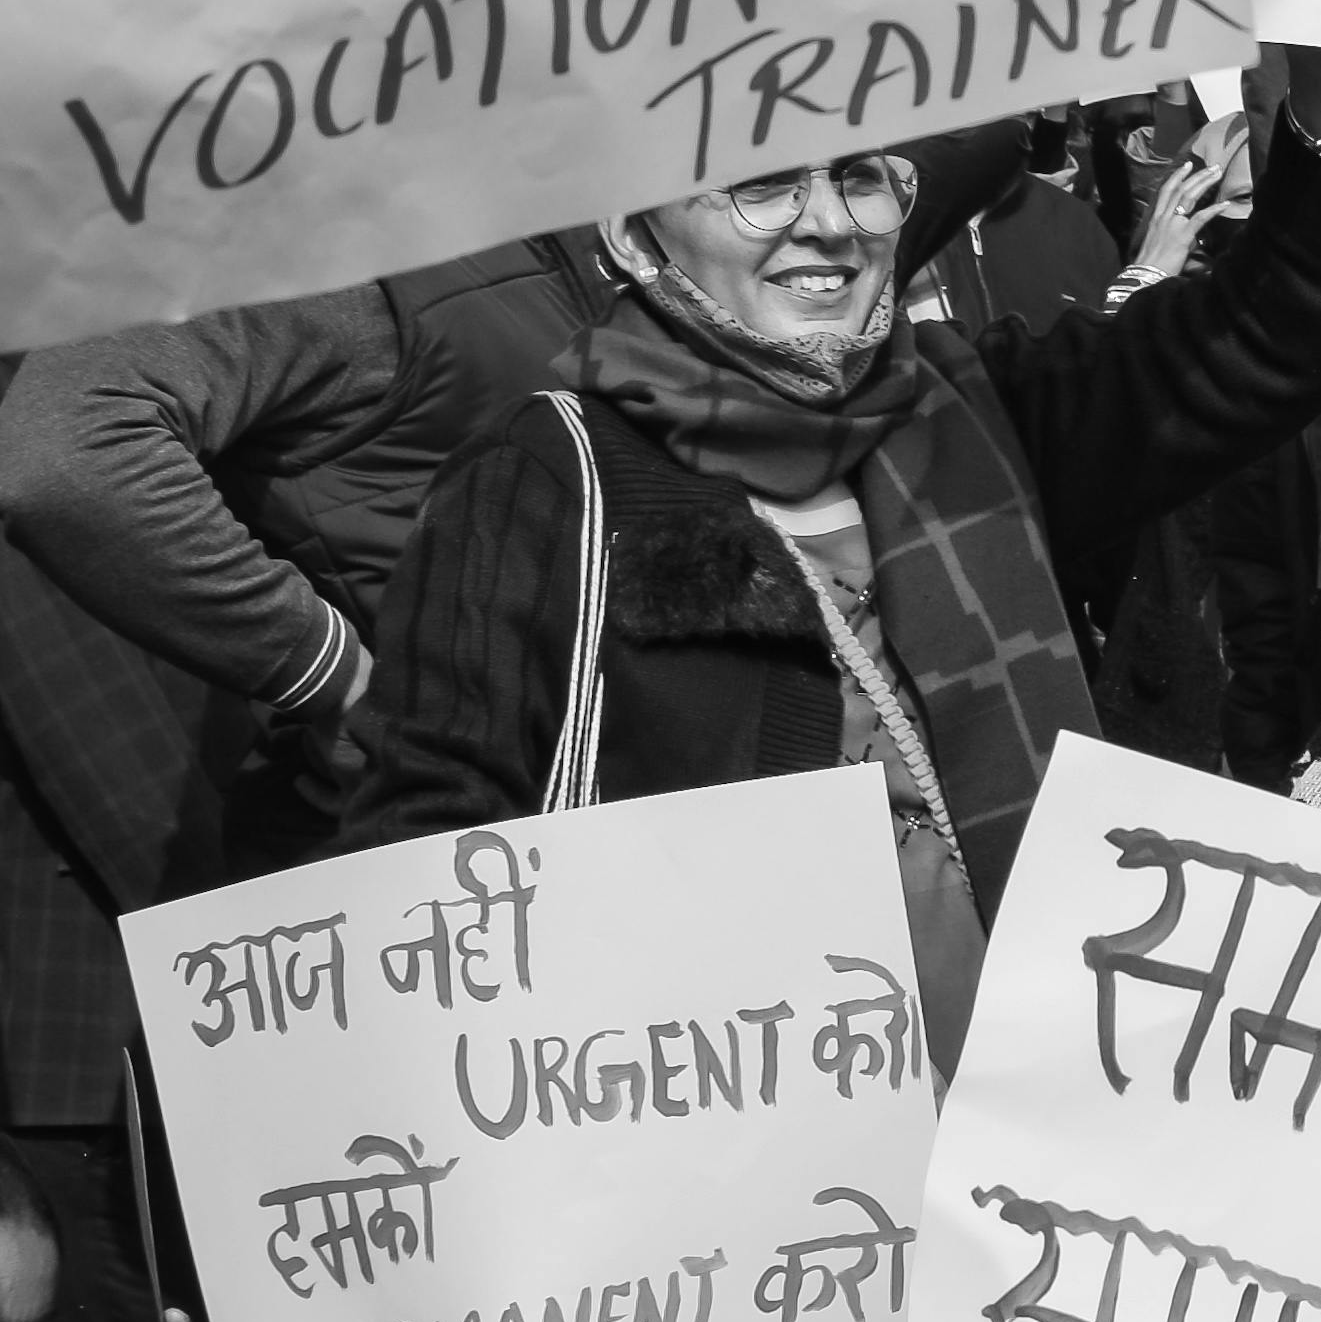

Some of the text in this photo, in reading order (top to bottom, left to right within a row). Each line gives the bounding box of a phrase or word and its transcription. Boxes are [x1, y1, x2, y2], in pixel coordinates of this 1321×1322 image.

[172, 829, 544, 1050] आज नहीं
[454, 998, 796, 1141] URGENT
